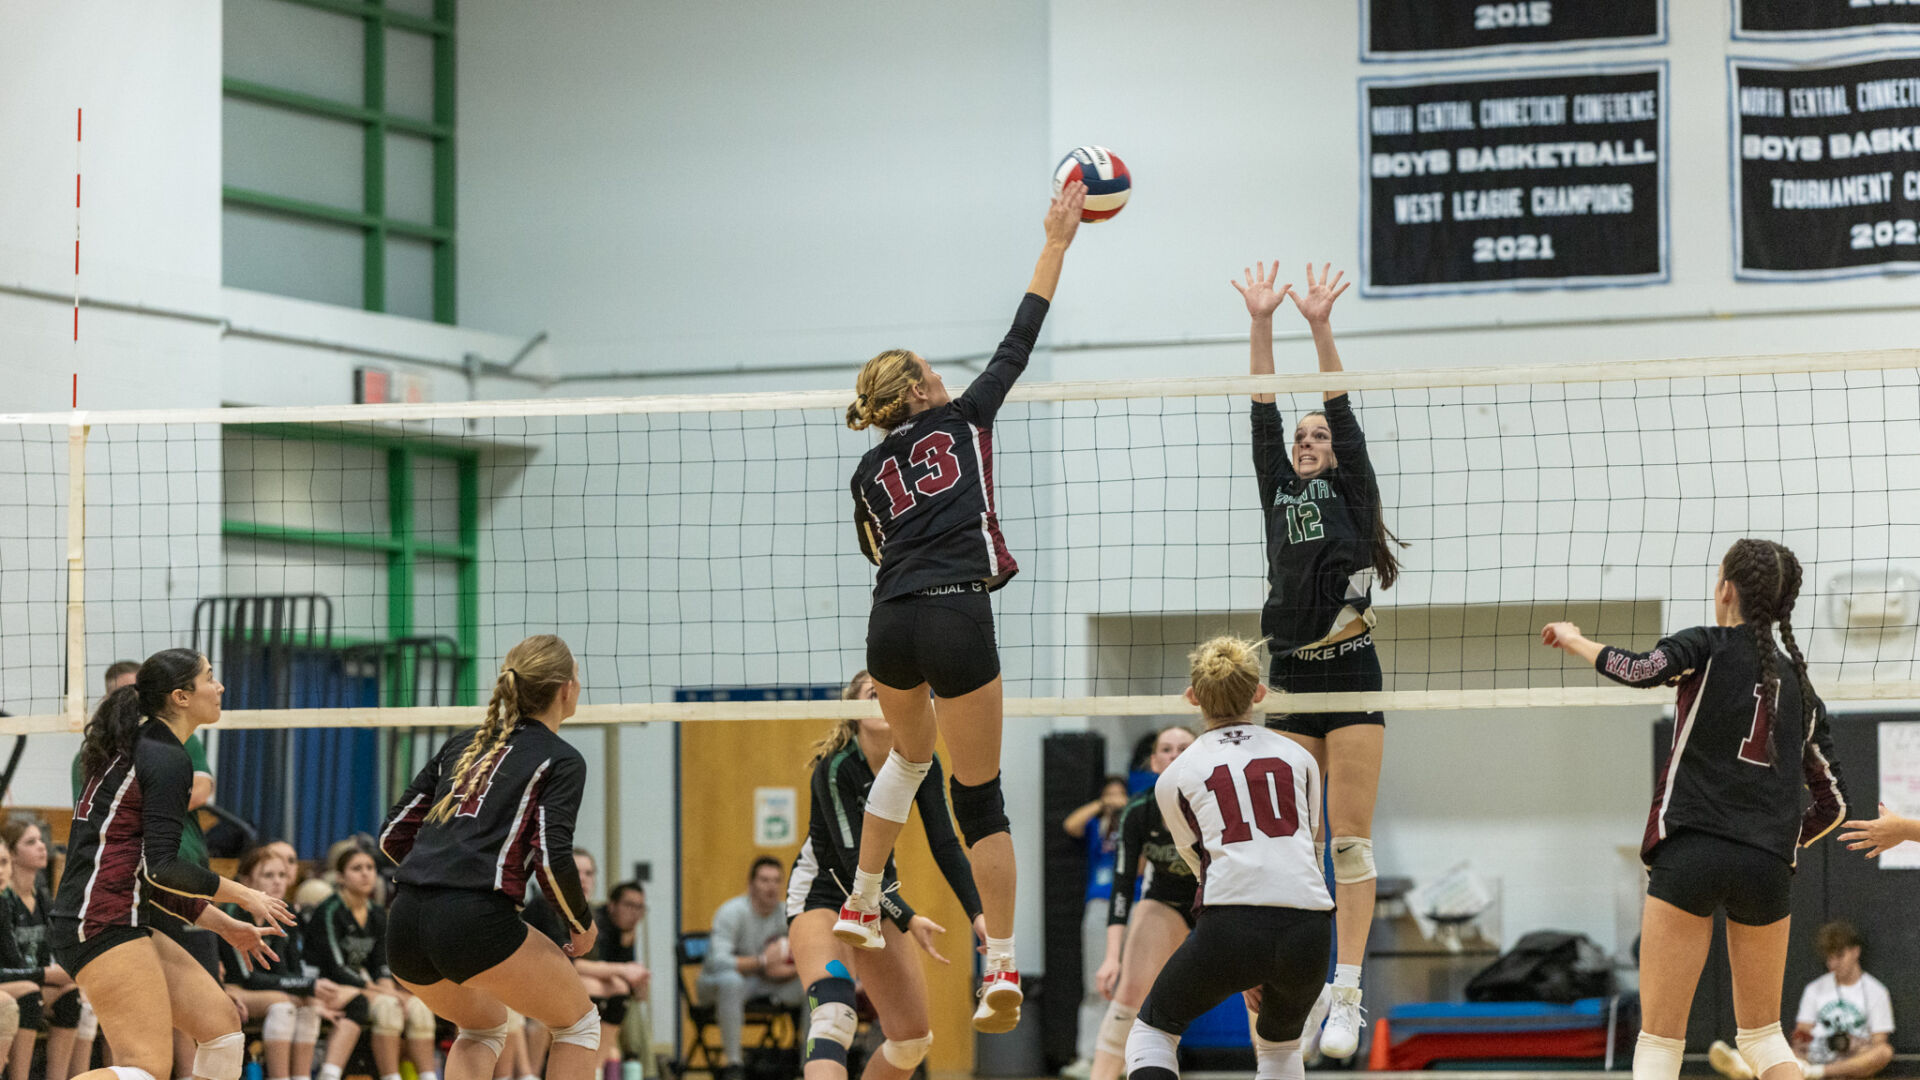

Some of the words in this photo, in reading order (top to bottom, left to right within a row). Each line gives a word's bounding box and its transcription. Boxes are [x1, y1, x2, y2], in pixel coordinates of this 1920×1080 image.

[1474, 1, 1552, 30] 2015
[1372, 105, 1413, 135] NORTH
[1417, 101, 1475, 133] CENTRAL
[1479, 95, 1567, 128] CONNECTICUT
[1573, 90, 1656, 123] CONFERENCE
[1741, 86, 1785, 117] NORTH
[1789, 85, 1850, 117] CENTRAL
[1372, 150, 1450, 177] BOYS
[1457, 139, 1656, 172] BASKETBALL
[1743, 134, 1823, 161] BOYS
[1394, 193, 1444, 224] WEST
[1453, 187, 1523, 220] LEAGUE
[1531, 183, 1633, 216] CHAMPIONS
[1771, 171, 1893, 209] TOURNAMENT
[1473, 234, 1554, 262] 2021
[1850, 219, 1920, 249] 202
[874, 430, 961, 520] 13
[1286, 502, 1324, 544] 12
[1292, 647, 1335, 661] NIKE
[1340, 634, 1372, 656] PRO
[1737, 679, 1781, 767] 1
[452, 746, 513, 817] 4
[1204, 757, 1299, 845] 10
